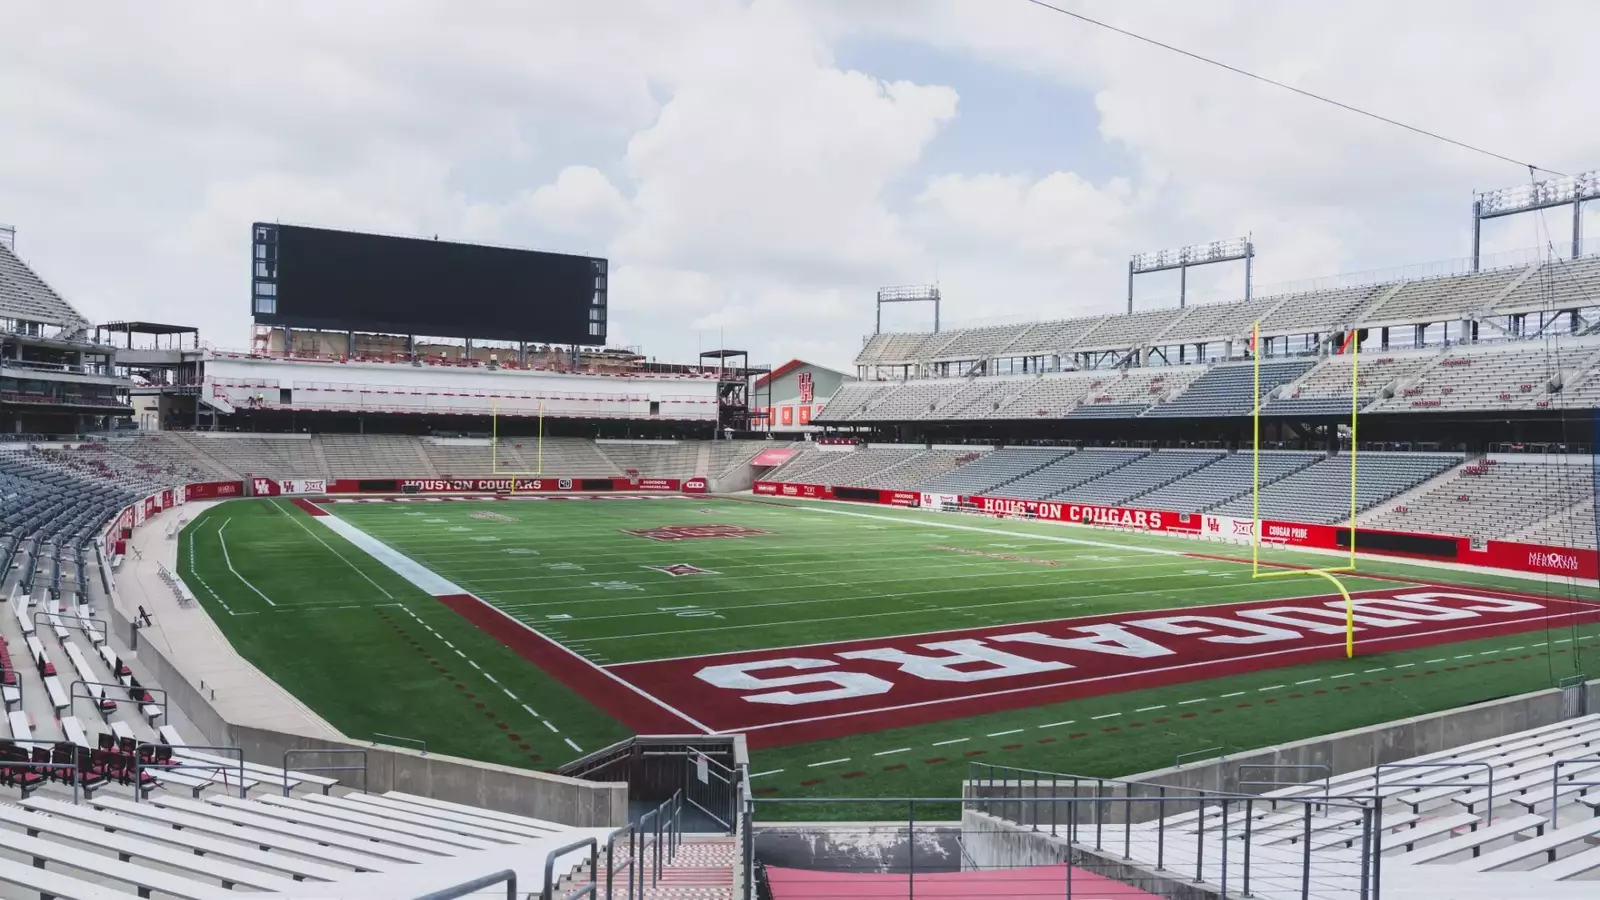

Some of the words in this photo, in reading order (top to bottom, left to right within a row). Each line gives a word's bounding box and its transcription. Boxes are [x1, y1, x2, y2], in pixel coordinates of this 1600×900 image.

[404, 480, 472, 490] HOUSTON
[478, 480, 542, 490] COUGARS
[984, 498, 1062, 518] HOUSTON
[1069, 505, 1162, 528] COUGARS
[1269, 525, 1290, 537] COUGAR
[1291, 527, 1308, 539] PRIDE
[1528, 557, 1578, 570] HERMANN
[1529, 552, 1577, 563] MEMORIAL
[693, 592, 1547, 706] COUGARS
